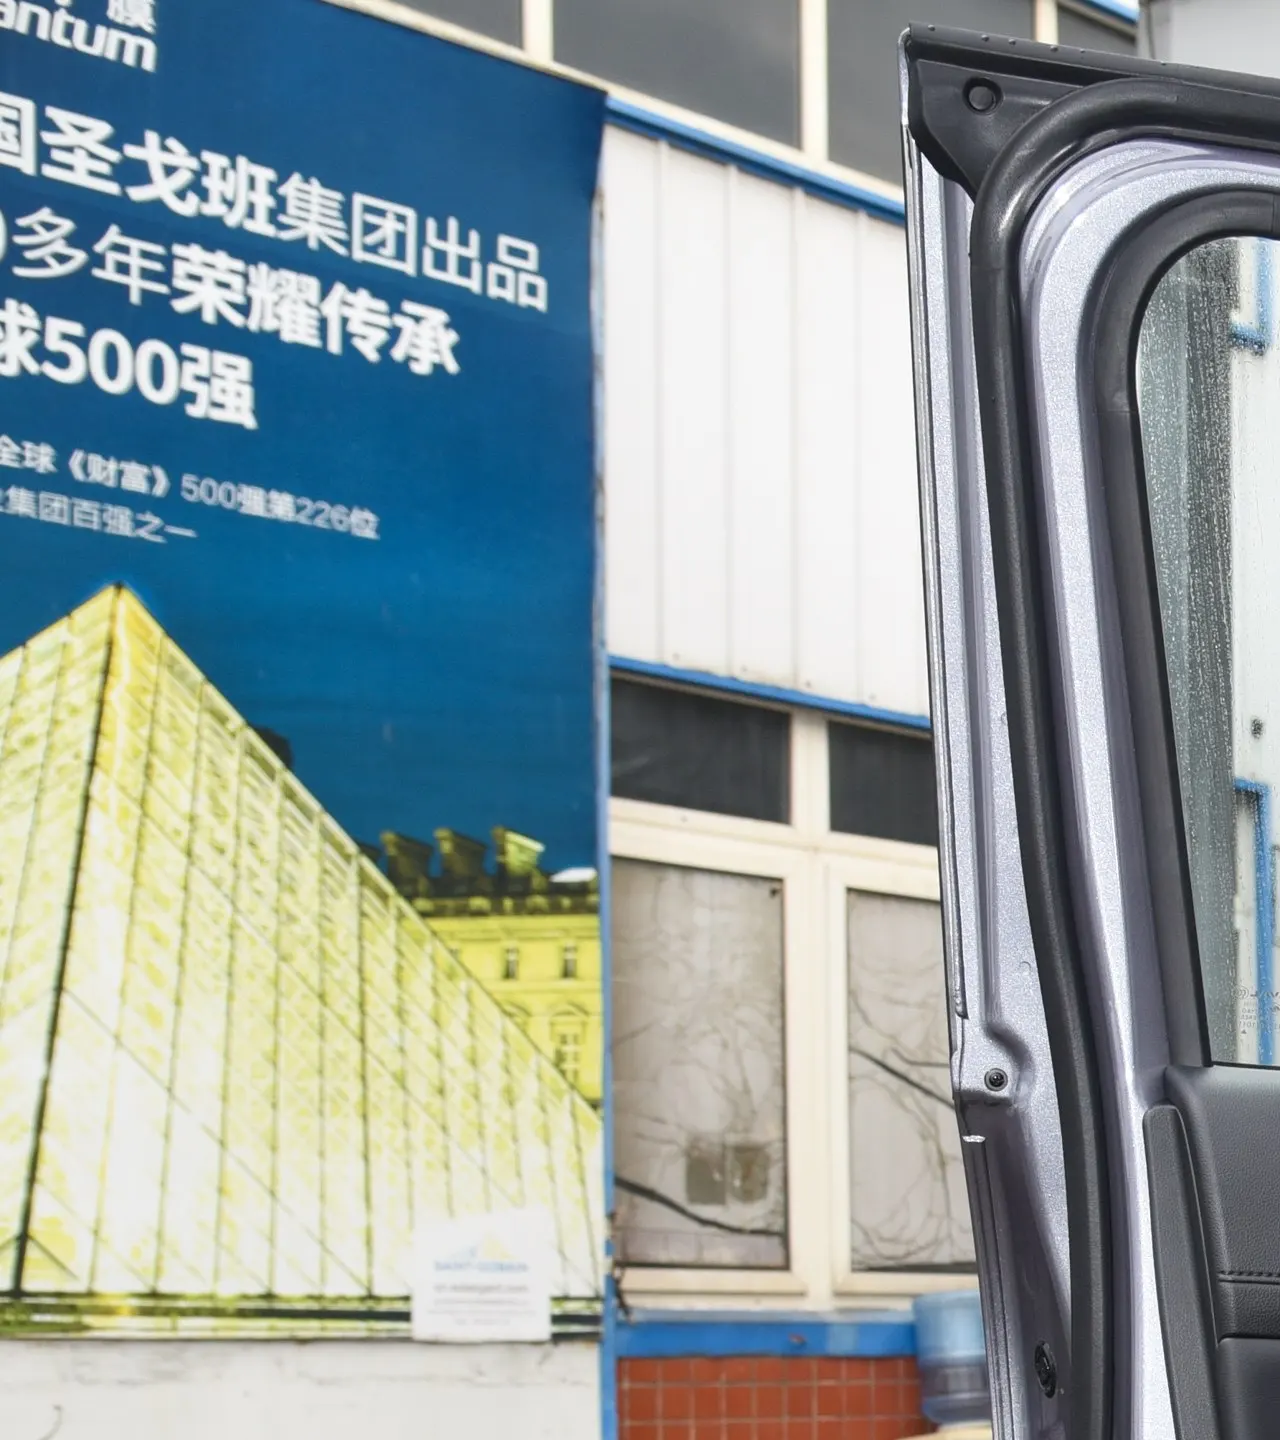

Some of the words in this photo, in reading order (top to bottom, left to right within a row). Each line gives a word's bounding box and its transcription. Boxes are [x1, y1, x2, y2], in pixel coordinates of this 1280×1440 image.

[0, 205, 461, 375] 多年荣耀传承
[0, 484, 198, 544] 集团百强之一
